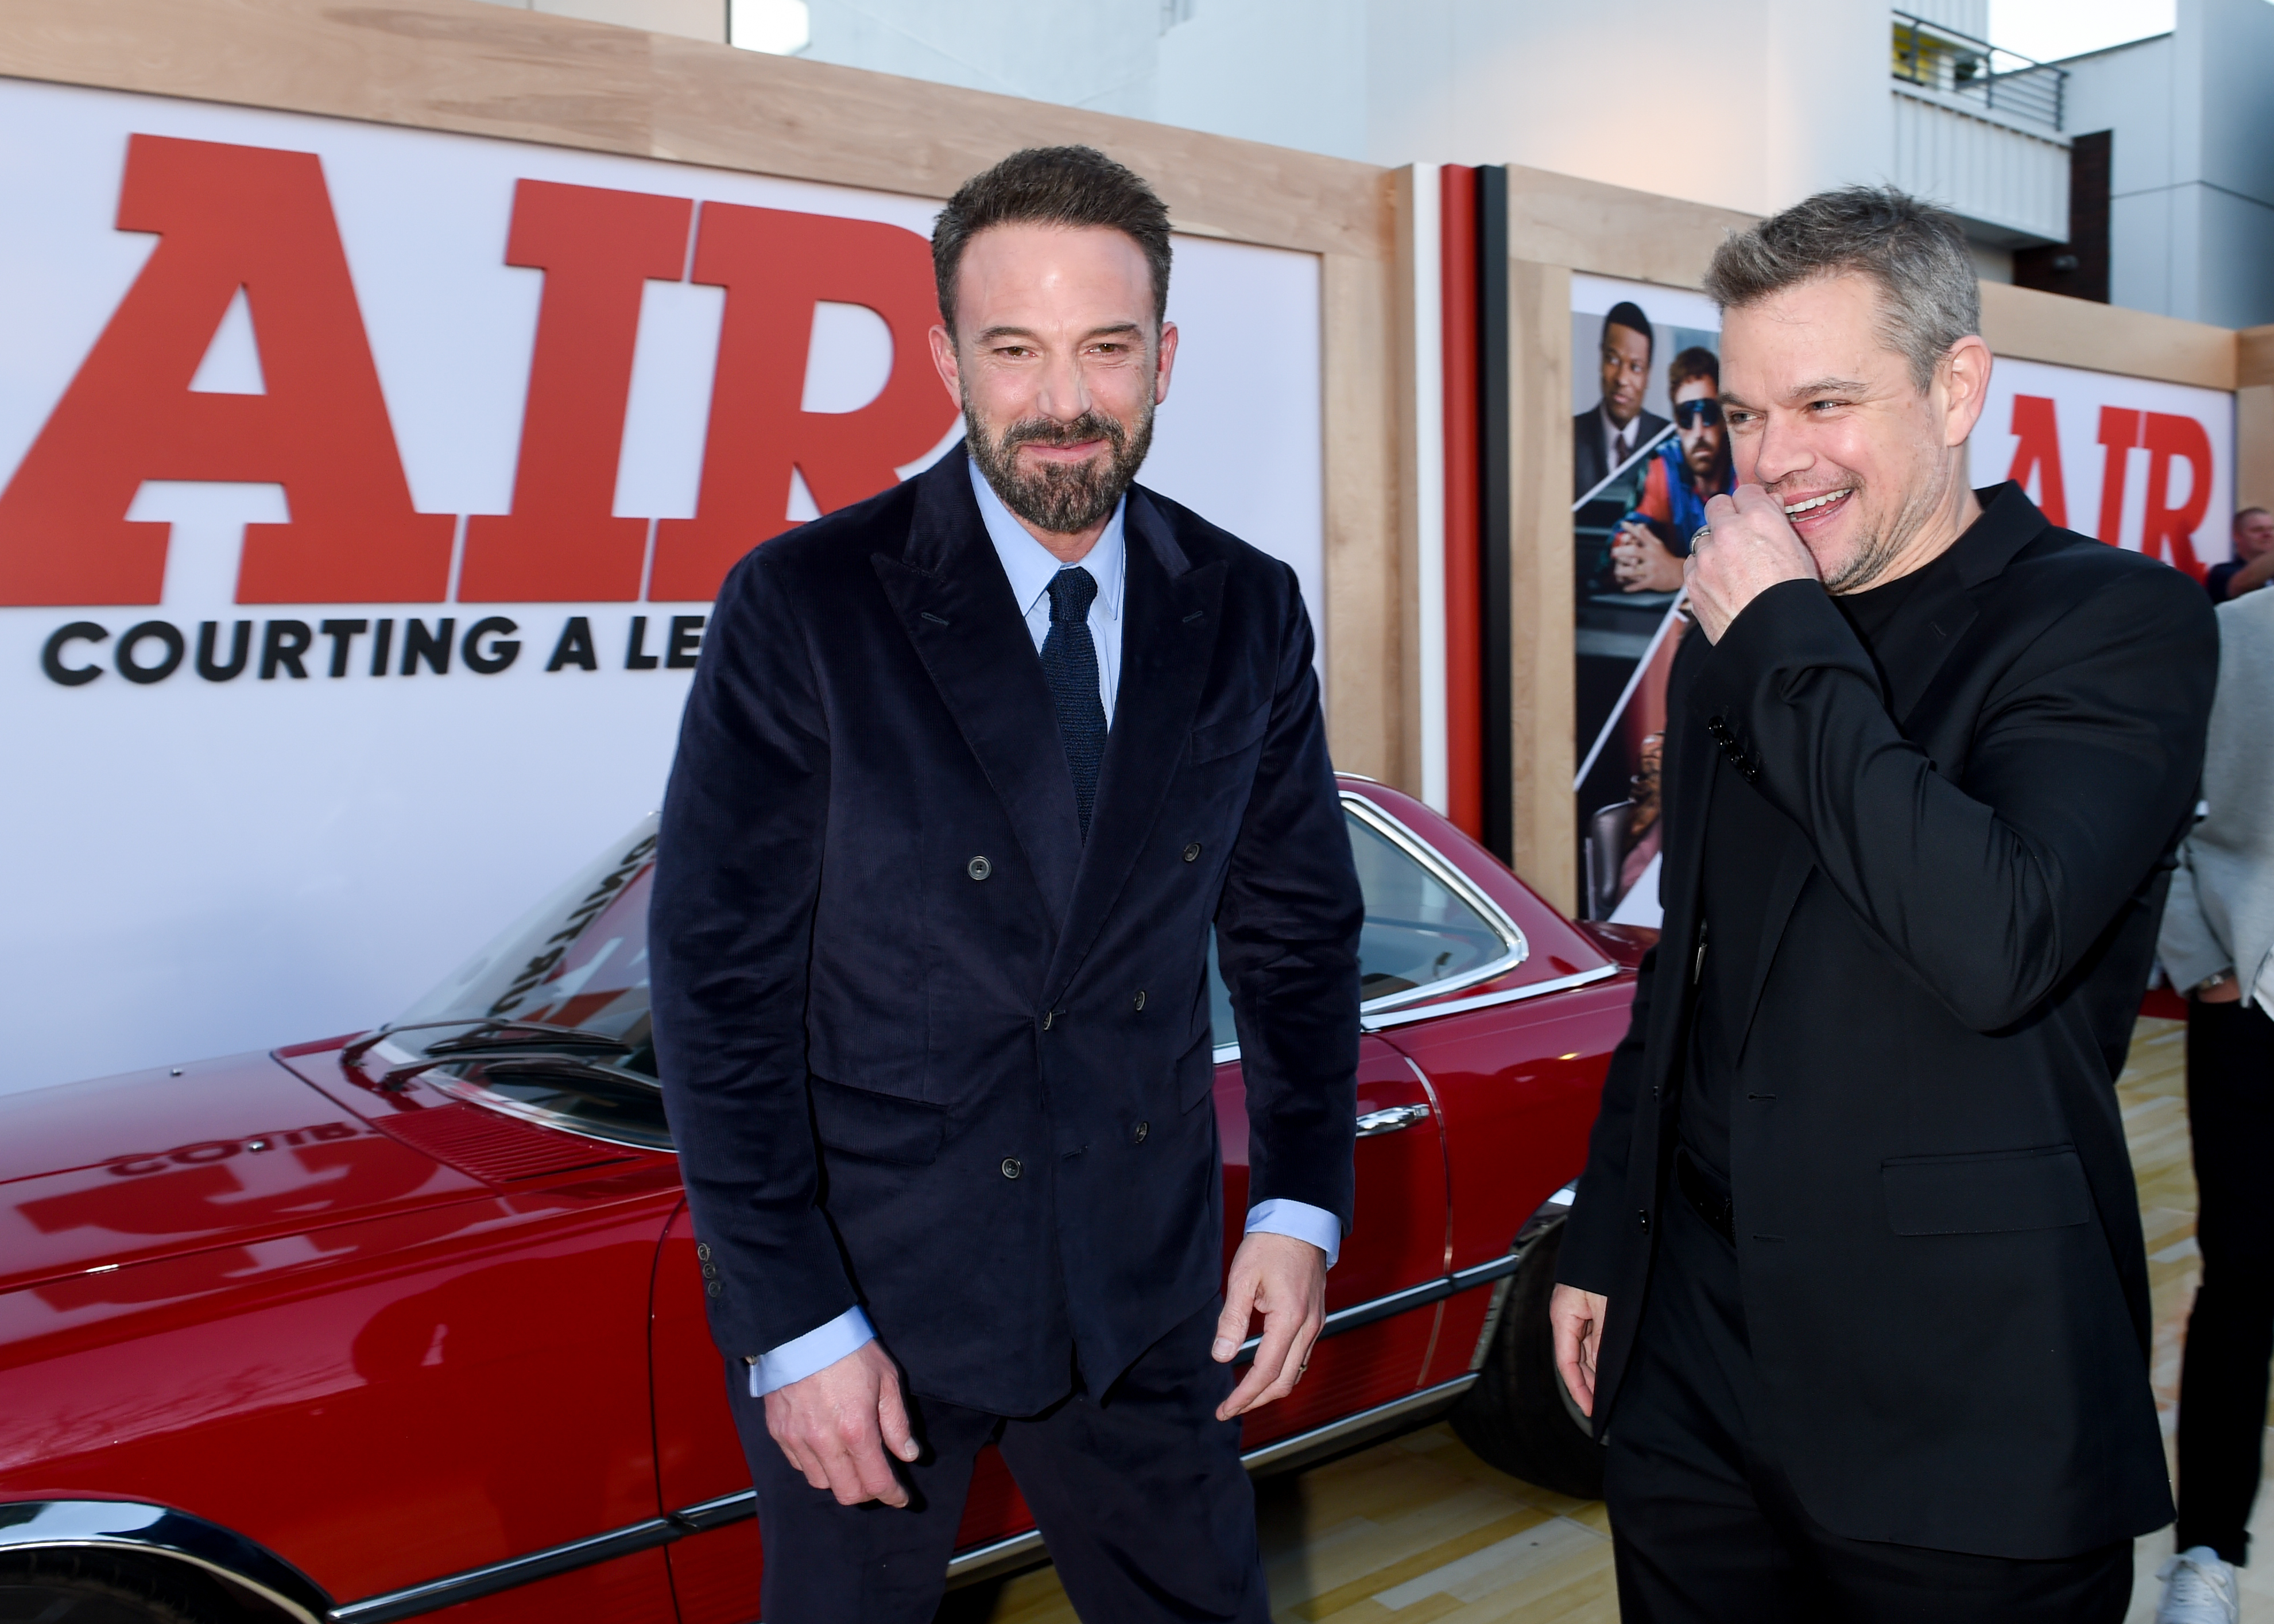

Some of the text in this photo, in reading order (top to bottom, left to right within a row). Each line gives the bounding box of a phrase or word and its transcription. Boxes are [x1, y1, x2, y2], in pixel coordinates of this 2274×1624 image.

[0, 133, 961, 606] AIR
[41, 617, 521, 687] COURTING
[546, 616, 598, 672] A
